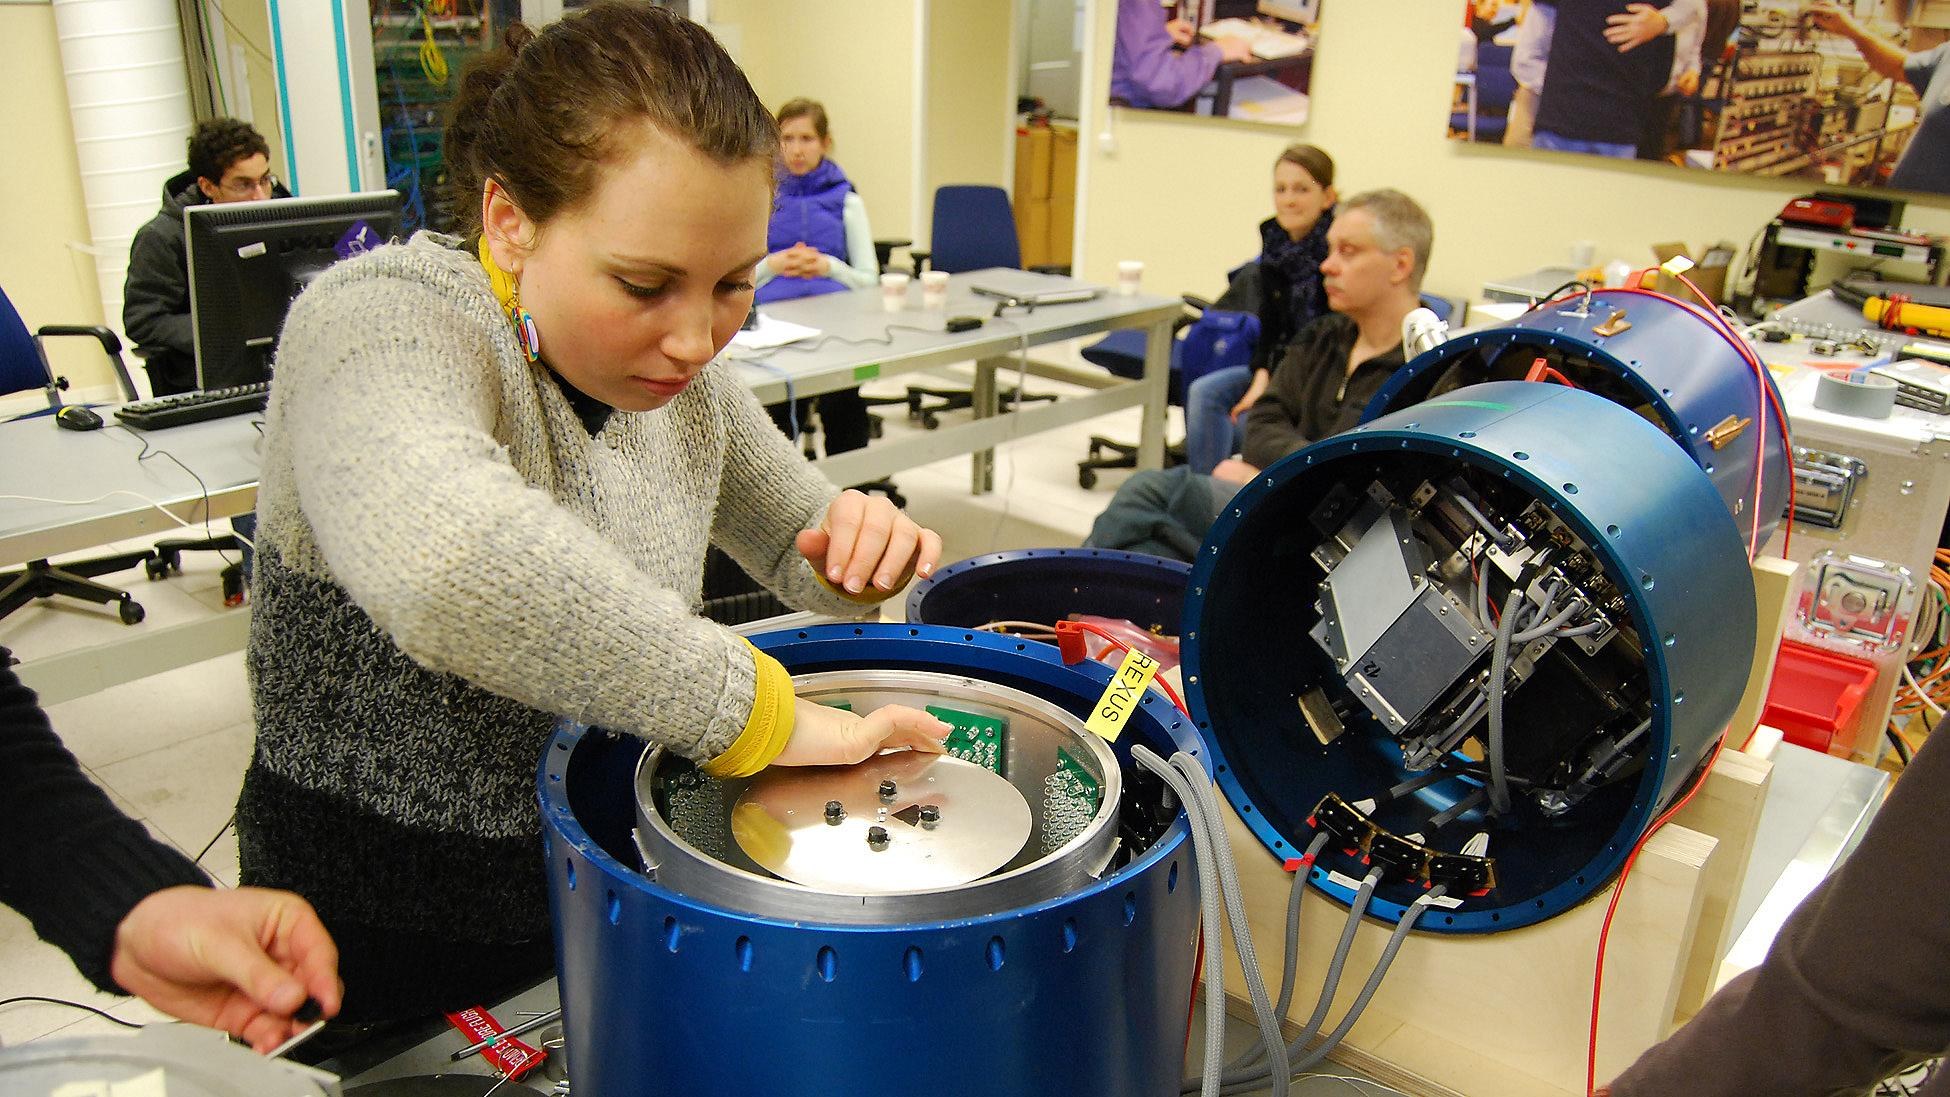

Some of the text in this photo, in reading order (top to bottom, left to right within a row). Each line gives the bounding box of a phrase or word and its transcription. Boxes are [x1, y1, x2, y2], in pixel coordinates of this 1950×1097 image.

[1101, 652, 1152, 722] REXUS
[459, 1008, 485, 1027] FLIGH
[495, 1042, 526, 1067] REMOE
